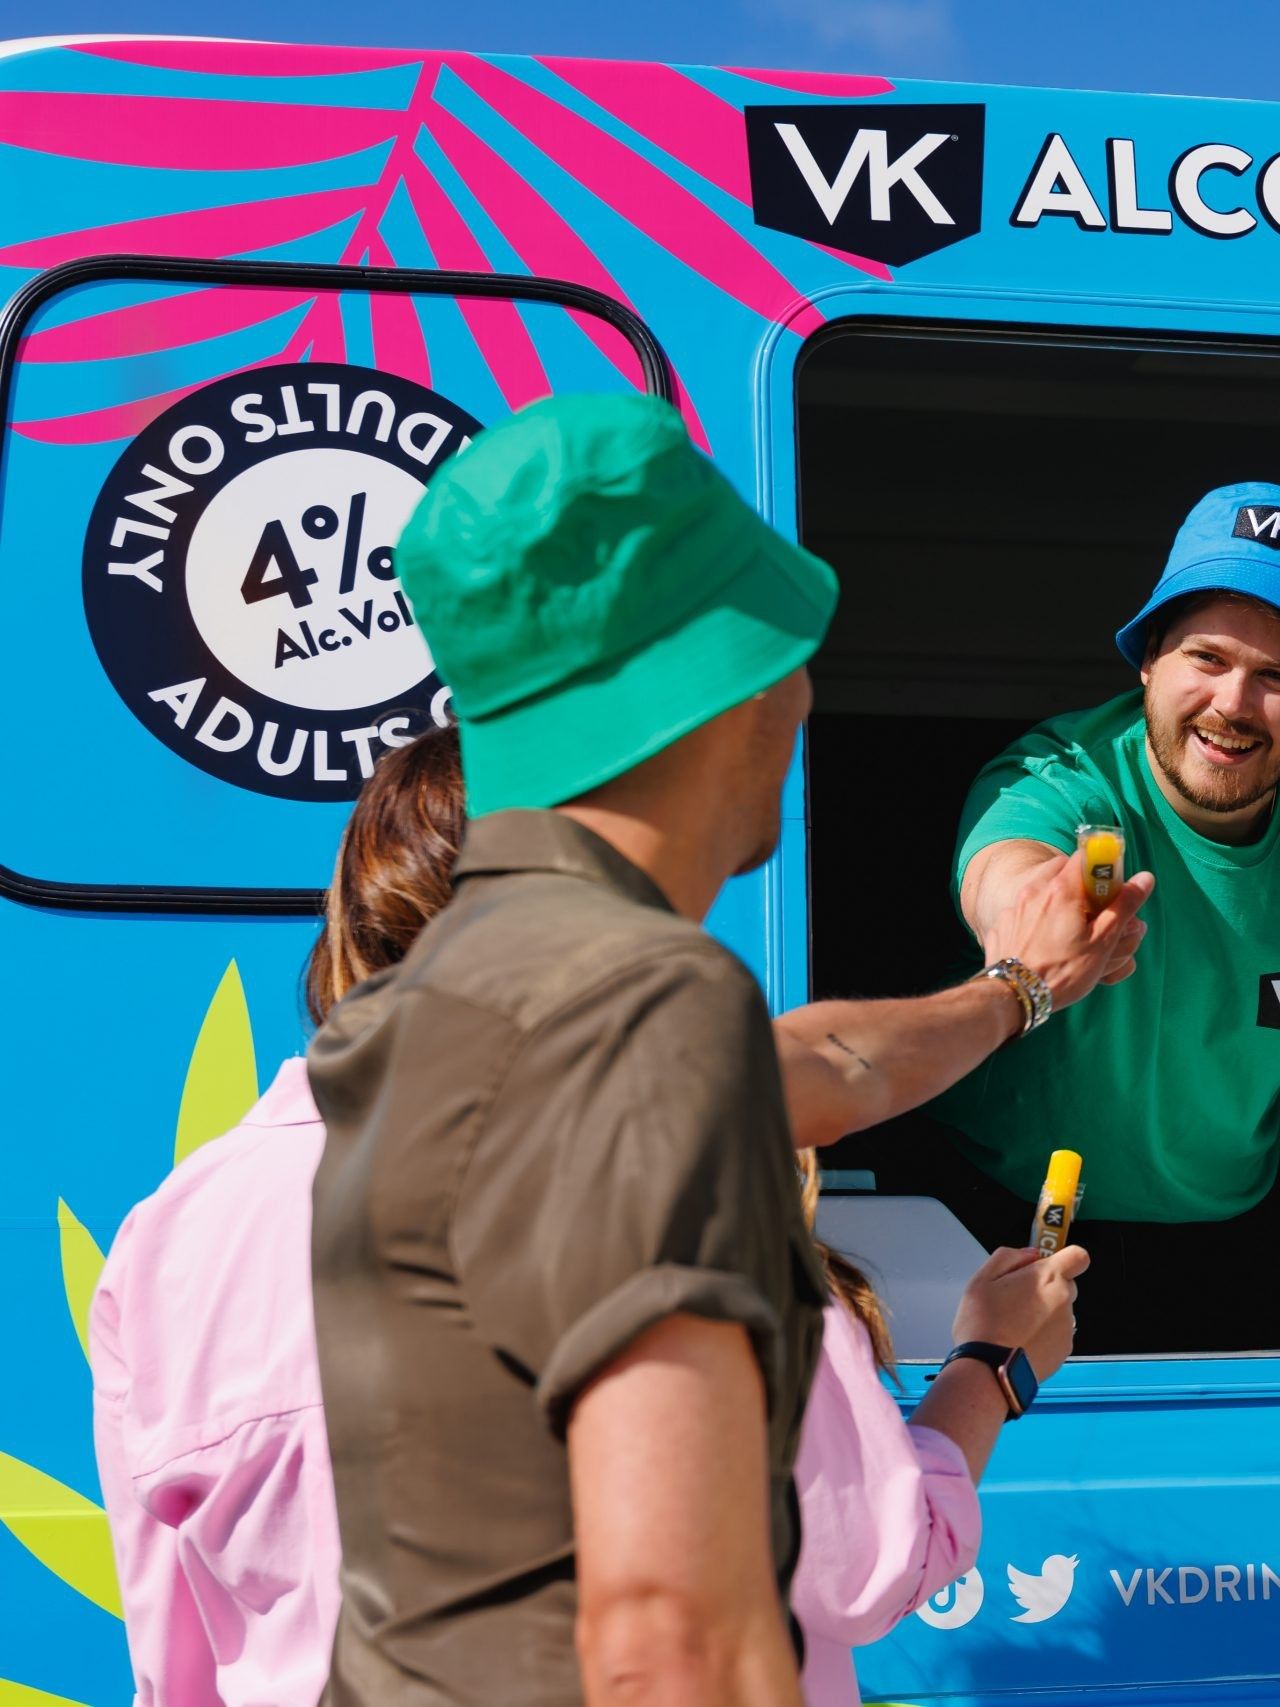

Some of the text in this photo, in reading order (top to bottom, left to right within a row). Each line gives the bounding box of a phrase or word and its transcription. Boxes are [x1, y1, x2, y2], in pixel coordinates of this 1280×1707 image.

[108, 383, 473, 592] DULTS ONLY
[240, 491, 401, 609] 4%
[1047, 1207, 1063, 1225] VK
